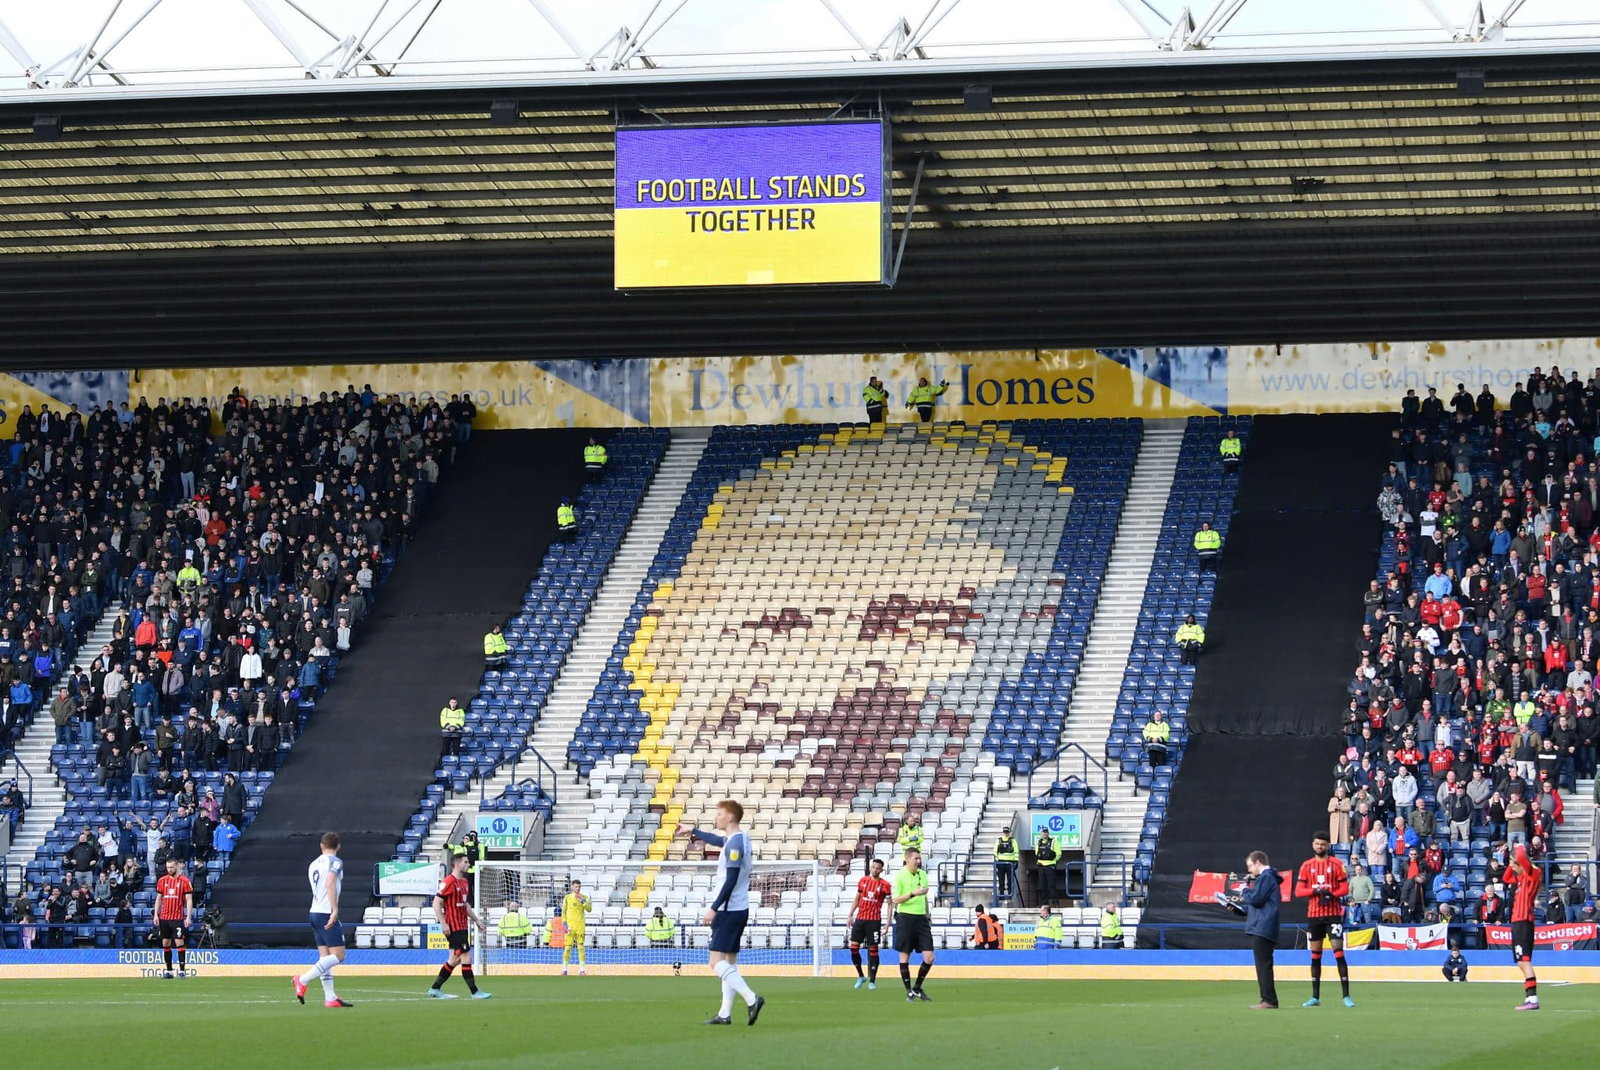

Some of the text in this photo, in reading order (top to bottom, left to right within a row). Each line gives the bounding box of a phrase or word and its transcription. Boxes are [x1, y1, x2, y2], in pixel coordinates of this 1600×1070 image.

[637, 173, 866, 203] FOOTBALL STANDS
[686, 208, 816, 233] TOGETHER
[935, 363, 1095, 407] Homes
[494, 820, 505, 830] 11
[1050, 818, 1063, 829] 12
[313, 870, 320, 888] 9
[176, 927, 182, 935] 2
[873, 931, 879, 939] 5
[1331, 923, 1343, 935] 29
[1491, 925, 1592, 940] CHTCHURCH
[177, 951, 219, 963] TANDS
